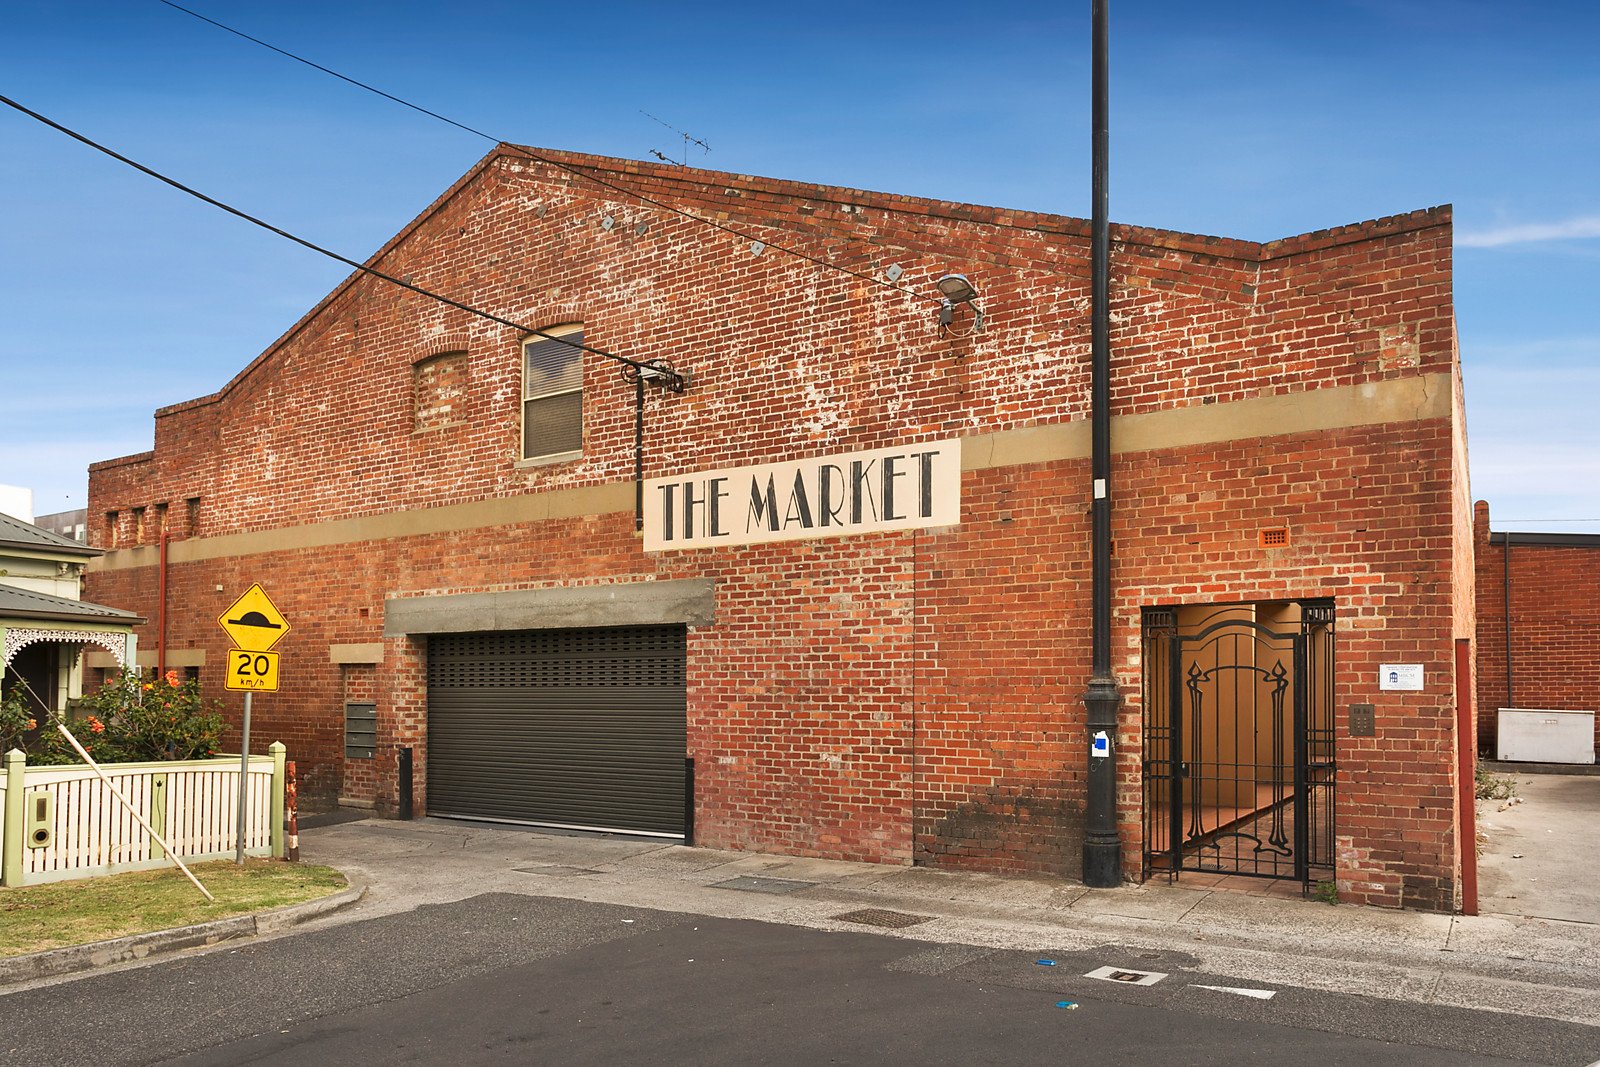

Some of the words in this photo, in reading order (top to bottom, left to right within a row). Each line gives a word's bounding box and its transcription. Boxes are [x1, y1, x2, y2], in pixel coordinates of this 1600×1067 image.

[657, 477, 730, 541] THE
[746, 451, 940, 534] MARKET
[237, 653, 270, 676] 20
[240, 678, 265, 688] km/h
